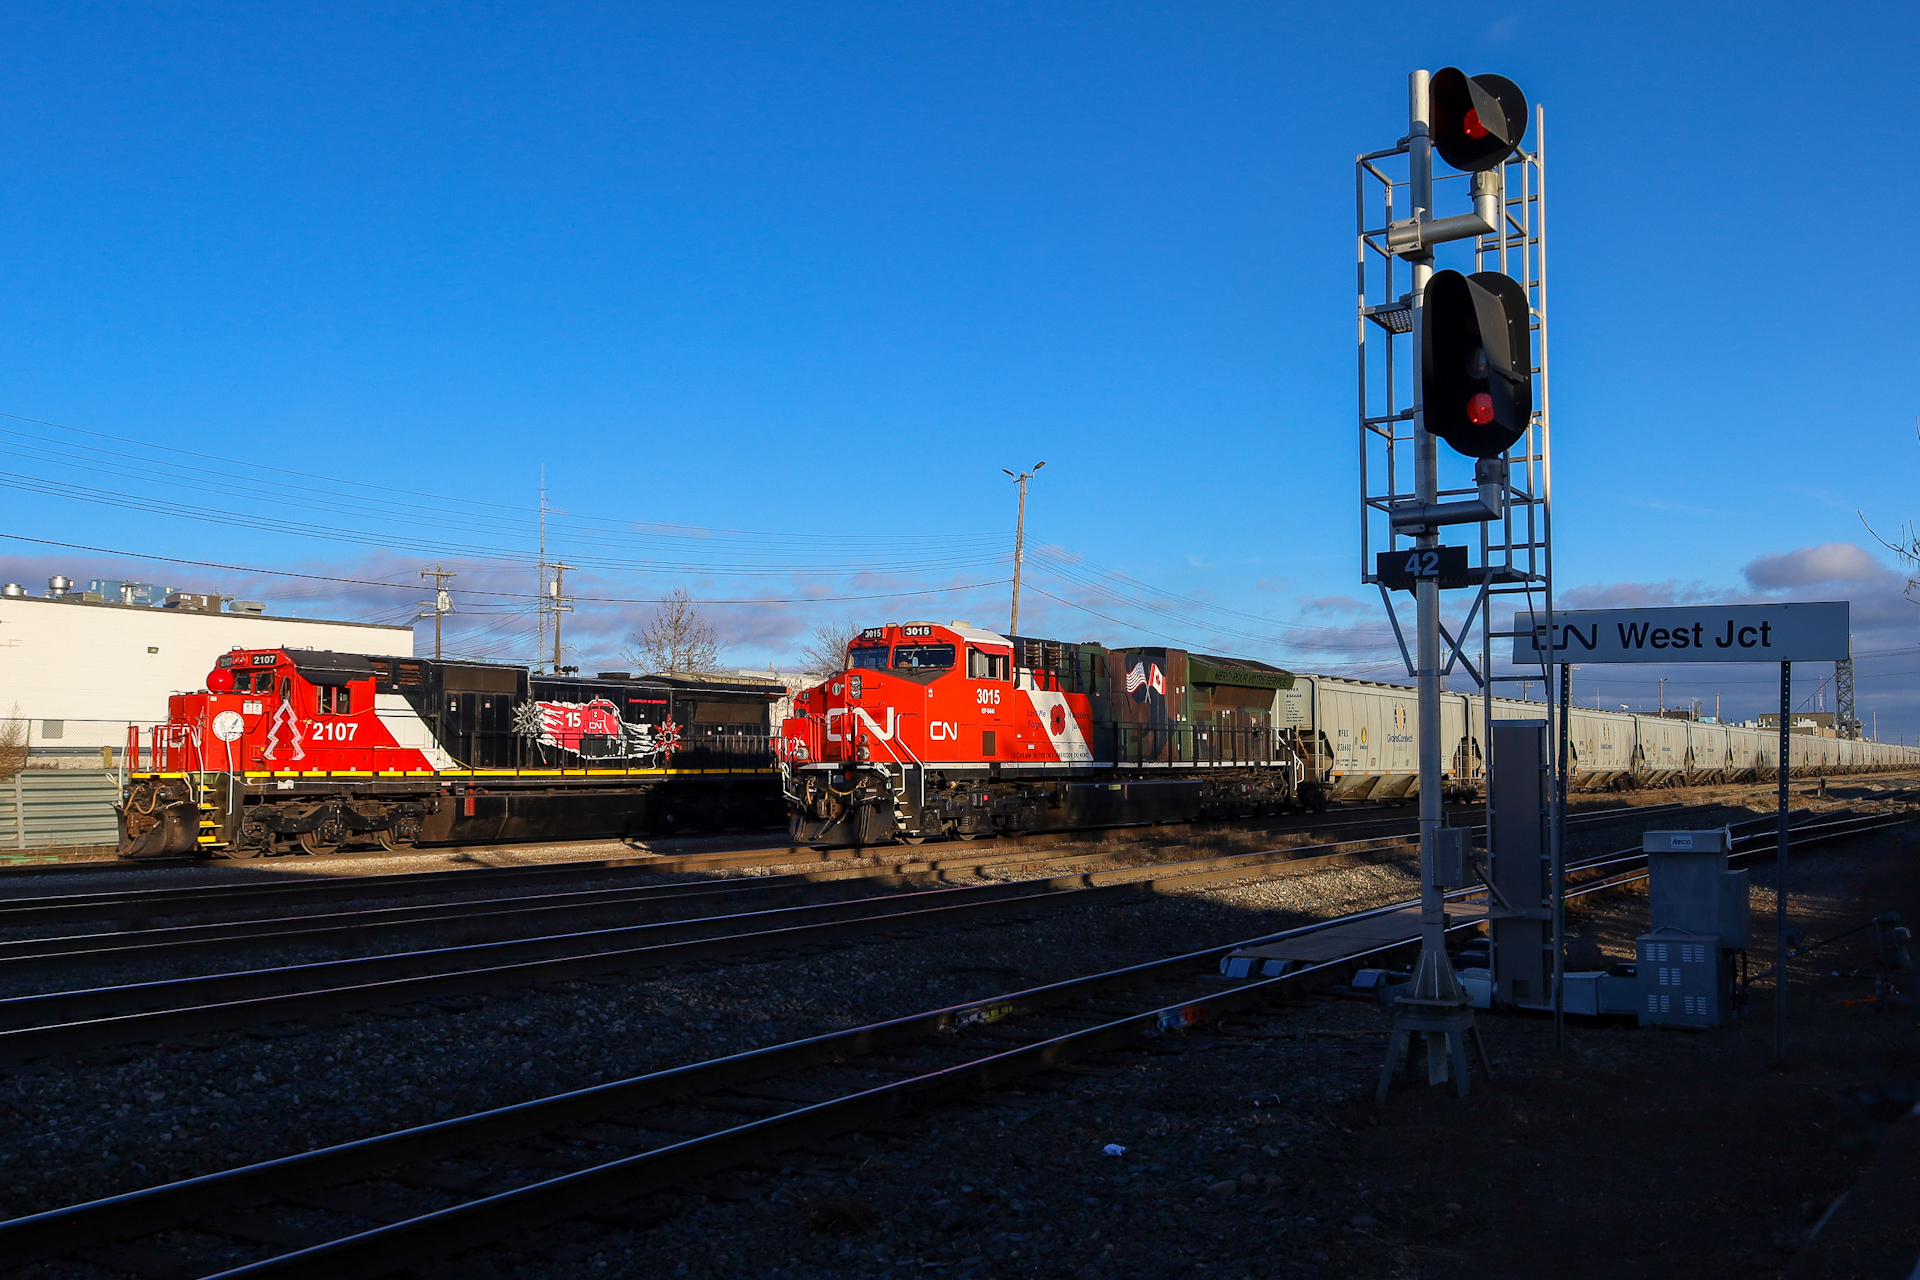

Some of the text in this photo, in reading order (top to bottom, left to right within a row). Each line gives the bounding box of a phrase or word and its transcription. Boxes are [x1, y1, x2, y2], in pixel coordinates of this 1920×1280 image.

[1404, 551, 1439, 577] 42
[864, 629, 882, 639] 3015
[905, 626, 930, 636] 3015
[1617, 622, 1704, 649] West
[1715, 620, 1772, 648] Jct
[253, 655, 276, 665] 2107
[1232, 672, 1248, 683] POUR
[1248, 674, 1266, 685] VOTRE
[1265, 675, 1288, 687] SERVICE
[976, 688, 1001, 705] 3015
[565, 712, 581, 727] 15
[312, 722, 359, 741] 2107
[930, 721, 957, 741] CN
[1387, 733, 1413, 743] GrainsConnect
